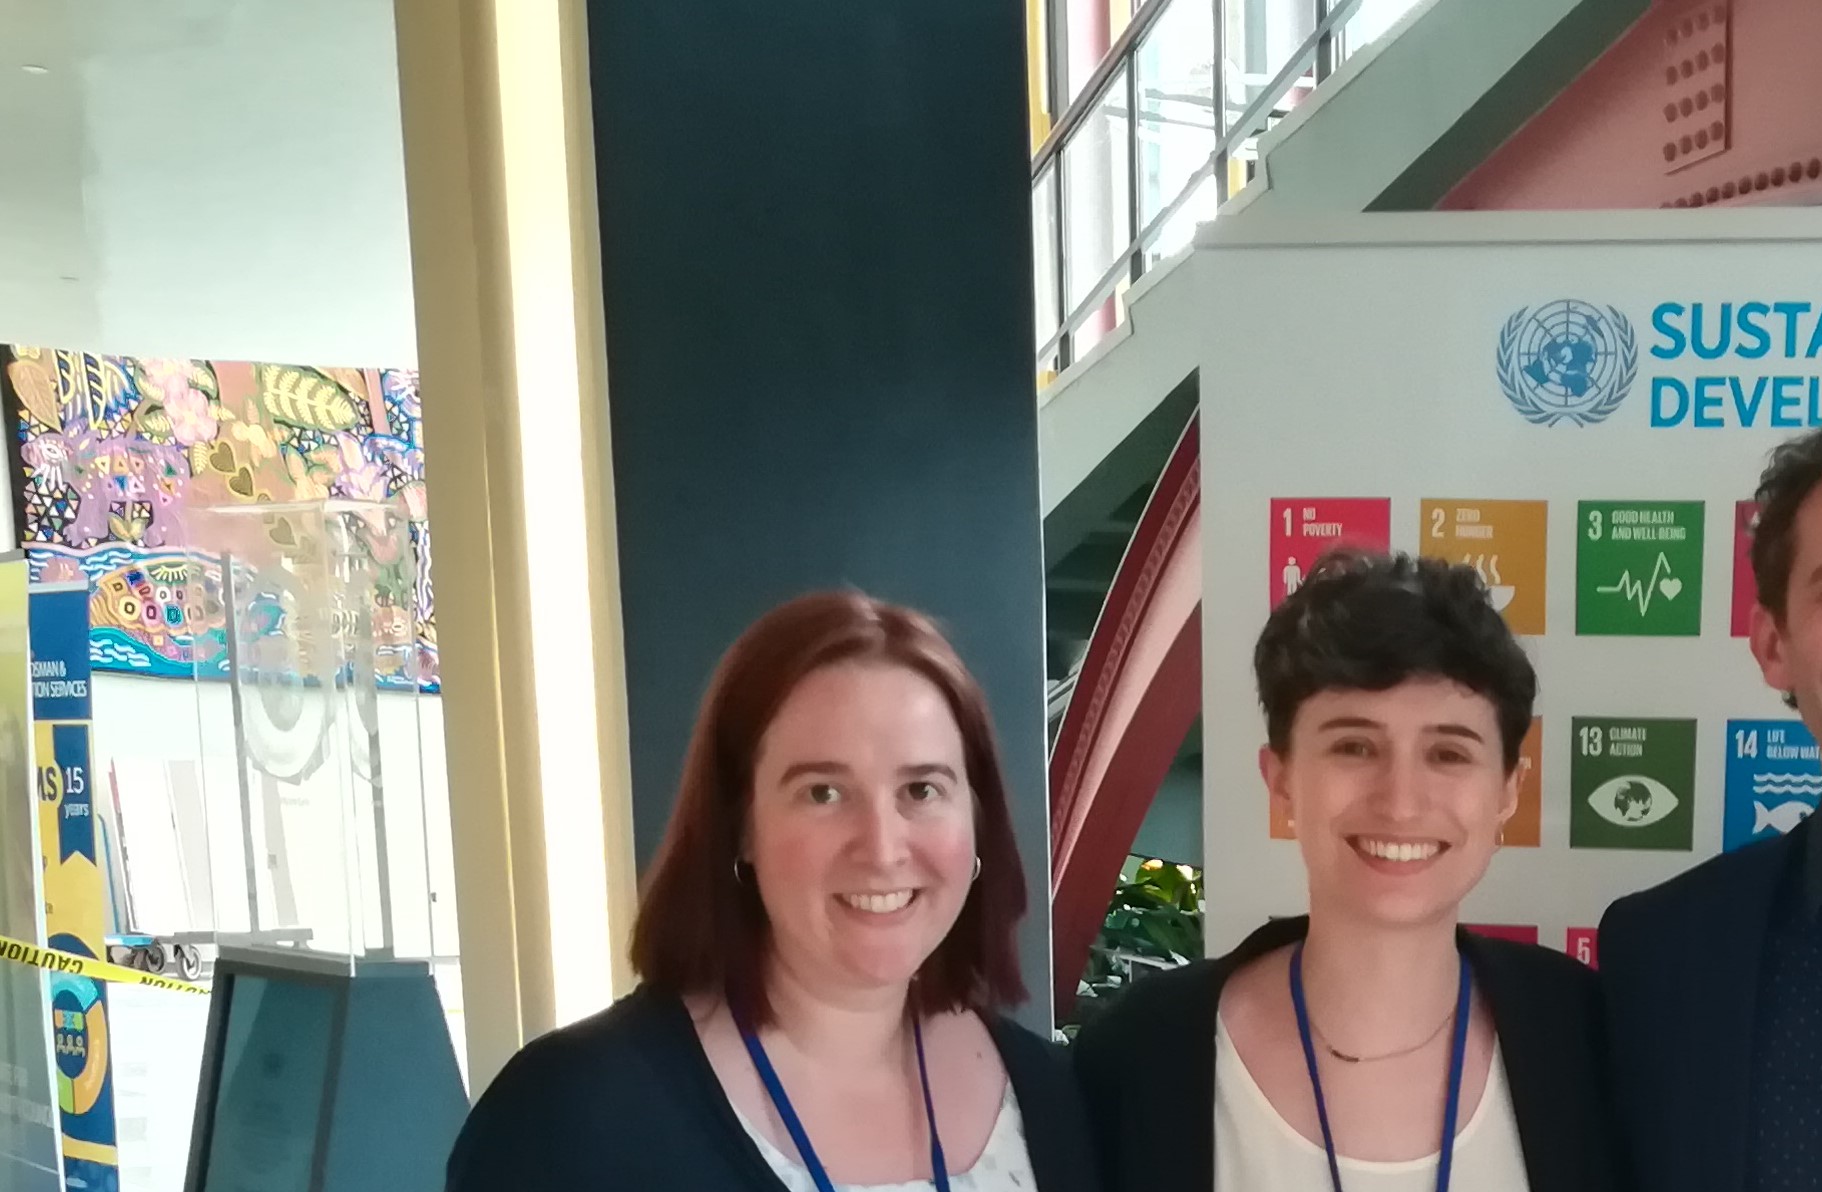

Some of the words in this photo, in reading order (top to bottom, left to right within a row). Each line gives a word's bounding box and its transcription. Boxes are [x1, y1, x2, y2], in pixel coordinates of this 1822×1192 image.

[1283, 508, 1292, 537] 1
[1303, 507, 1316, 521] NO
[1431, 508, 1446, 538] 2
[1588, 510, 1603, 541] 3
[1303, 523, 1343, 537] POVERTY
[1611, 526, 1632, 540] AND
[1579, 726, 1603, 756] 13
[1735, 729, 1758, 759] 14
[66, 766, 85, 795] 15
